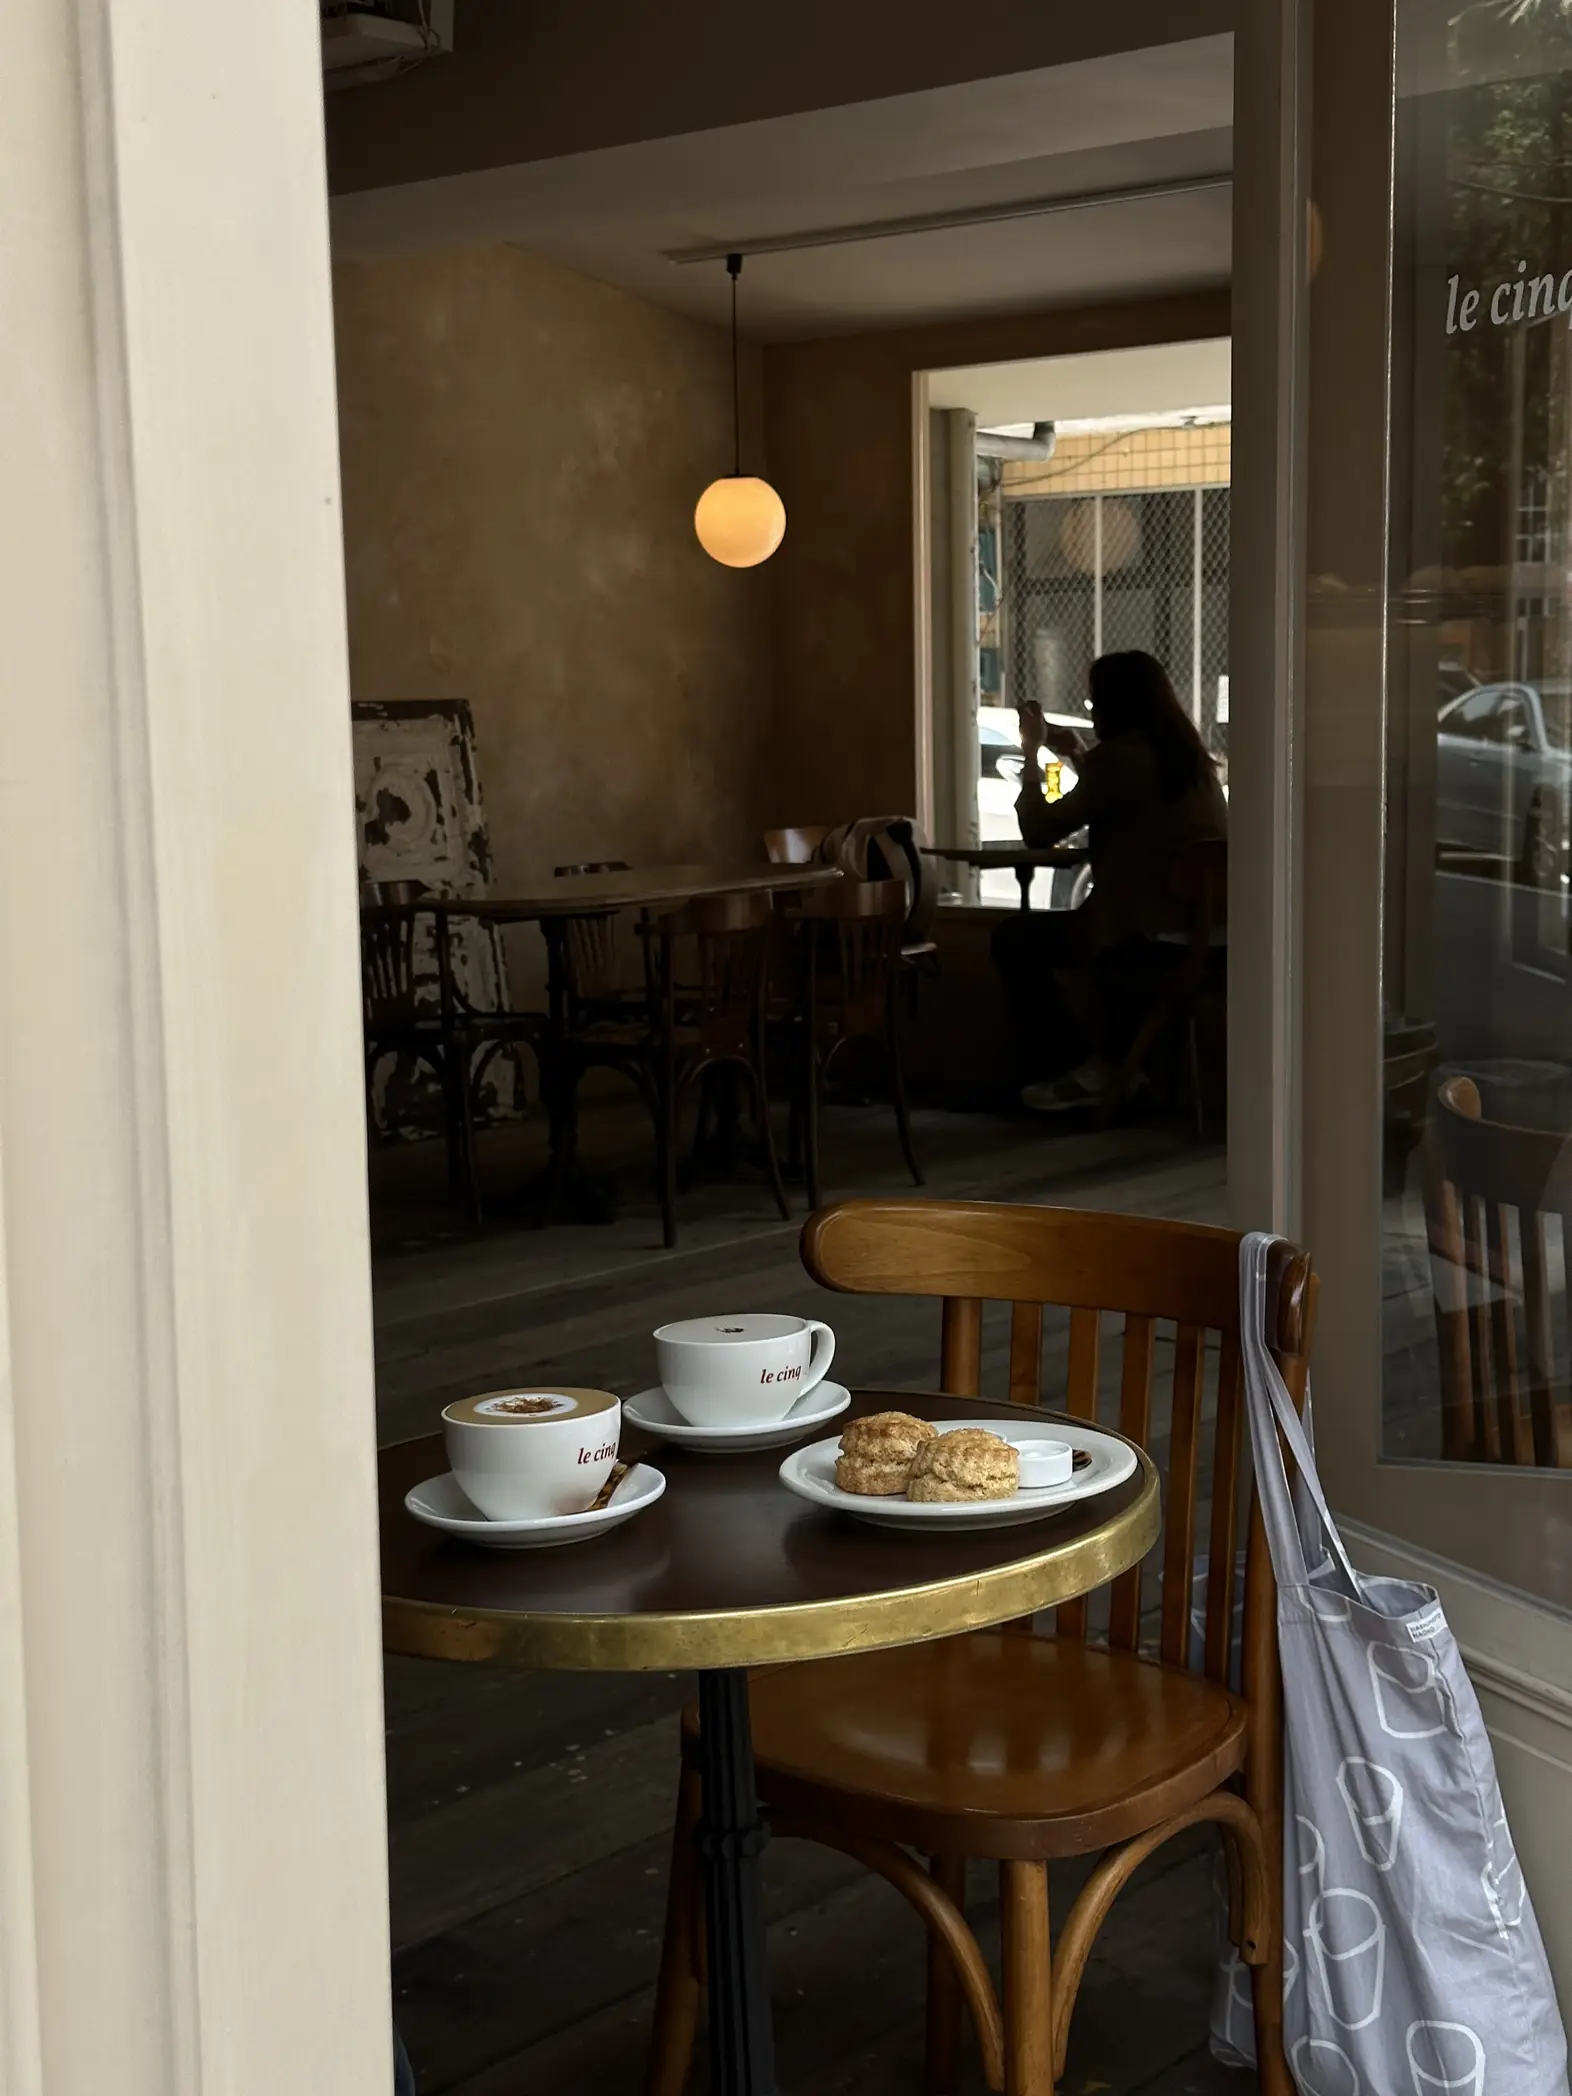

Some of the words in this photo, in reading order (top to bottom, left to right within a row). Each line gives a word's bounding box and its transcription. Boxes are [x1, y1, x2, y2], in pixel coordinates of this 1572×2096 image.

[1446, 274, 1480, 335] le
[760, 1368, 774, 1384] le
[776, 1365, 802, 1382] cinq
[577, 1447, 591, 1465] le
[593, 1442, 616, 1462] cinq
